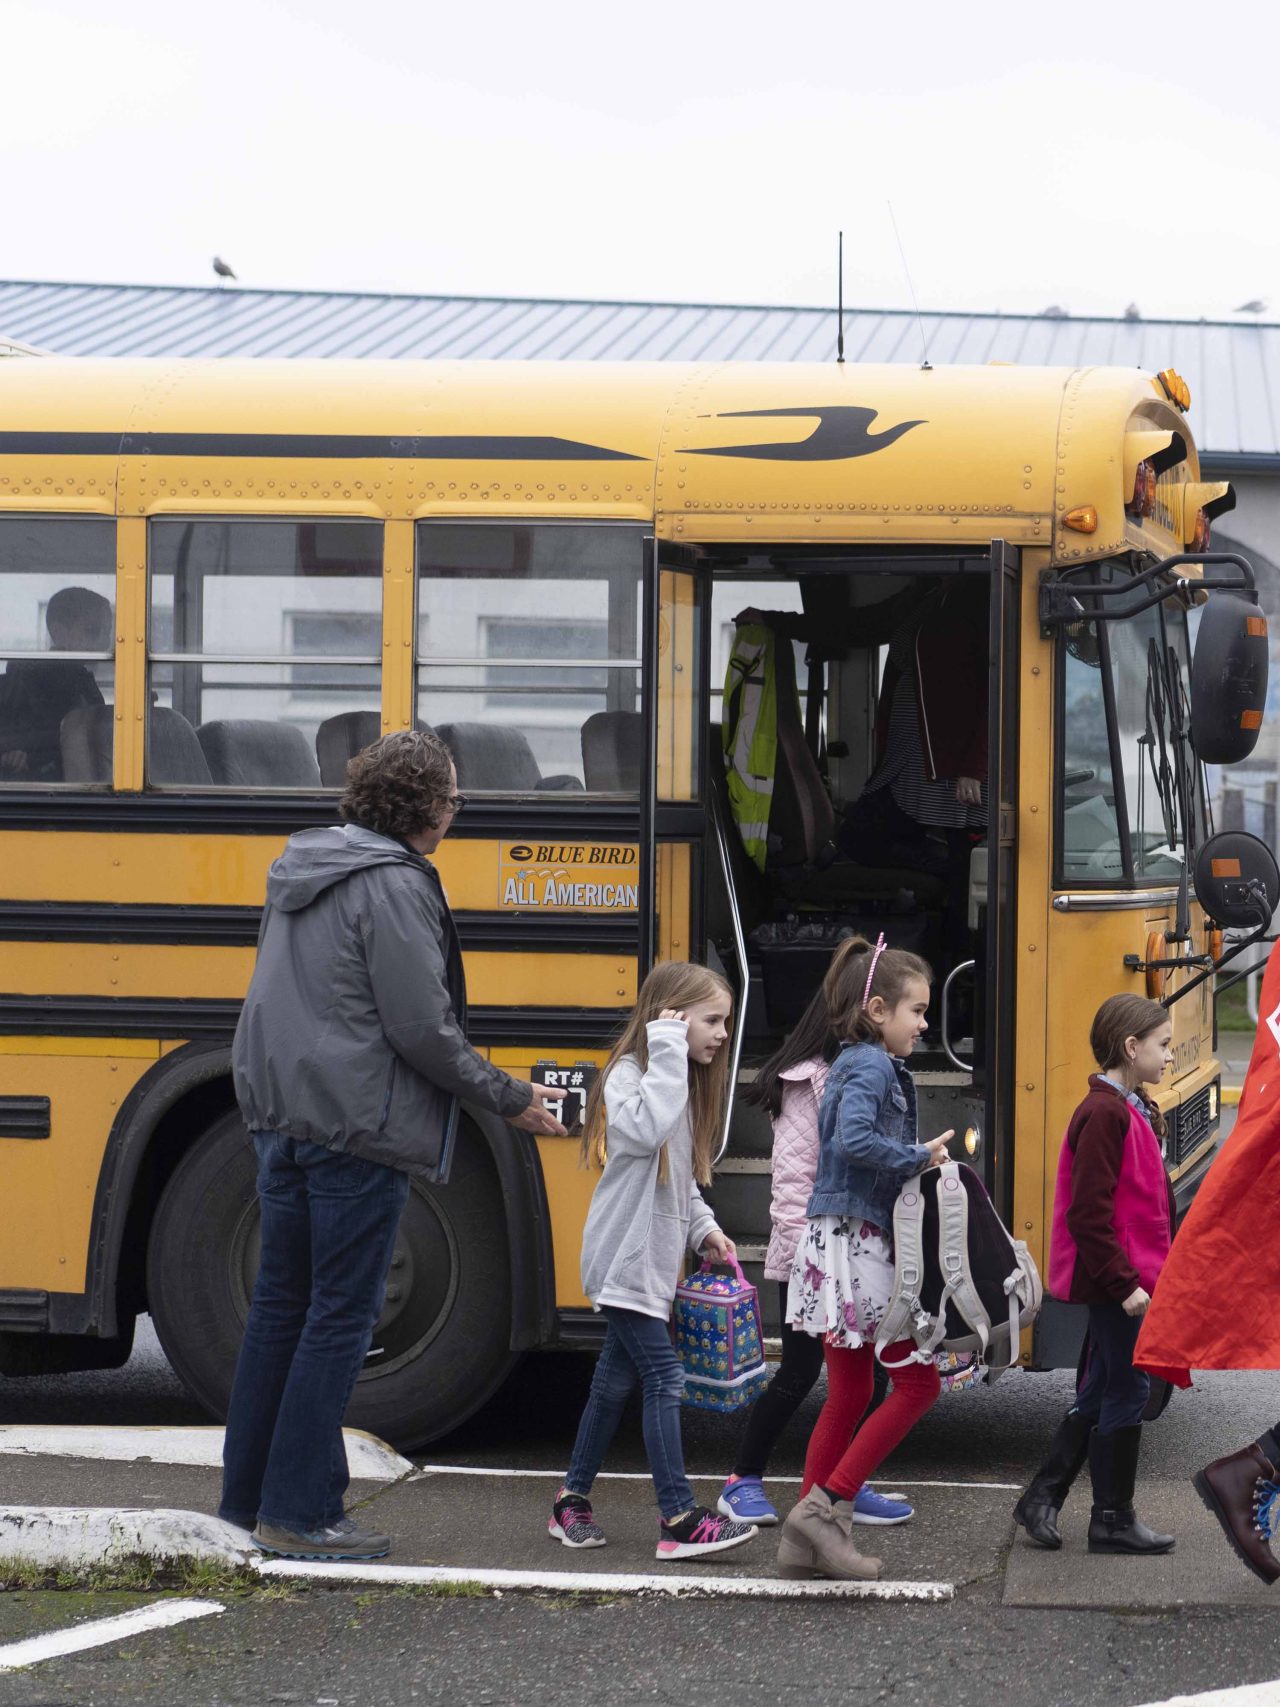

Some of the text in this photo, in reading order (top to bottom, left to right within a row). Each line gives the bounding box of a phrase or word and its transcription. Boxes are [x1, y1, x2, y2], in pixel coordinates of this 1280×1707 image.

[535, 846, 635, 864] BLUE BIRD
[503, 878, 639, 907] ALL AMERICAN
[544, 1071, 584, 1086] RT#
